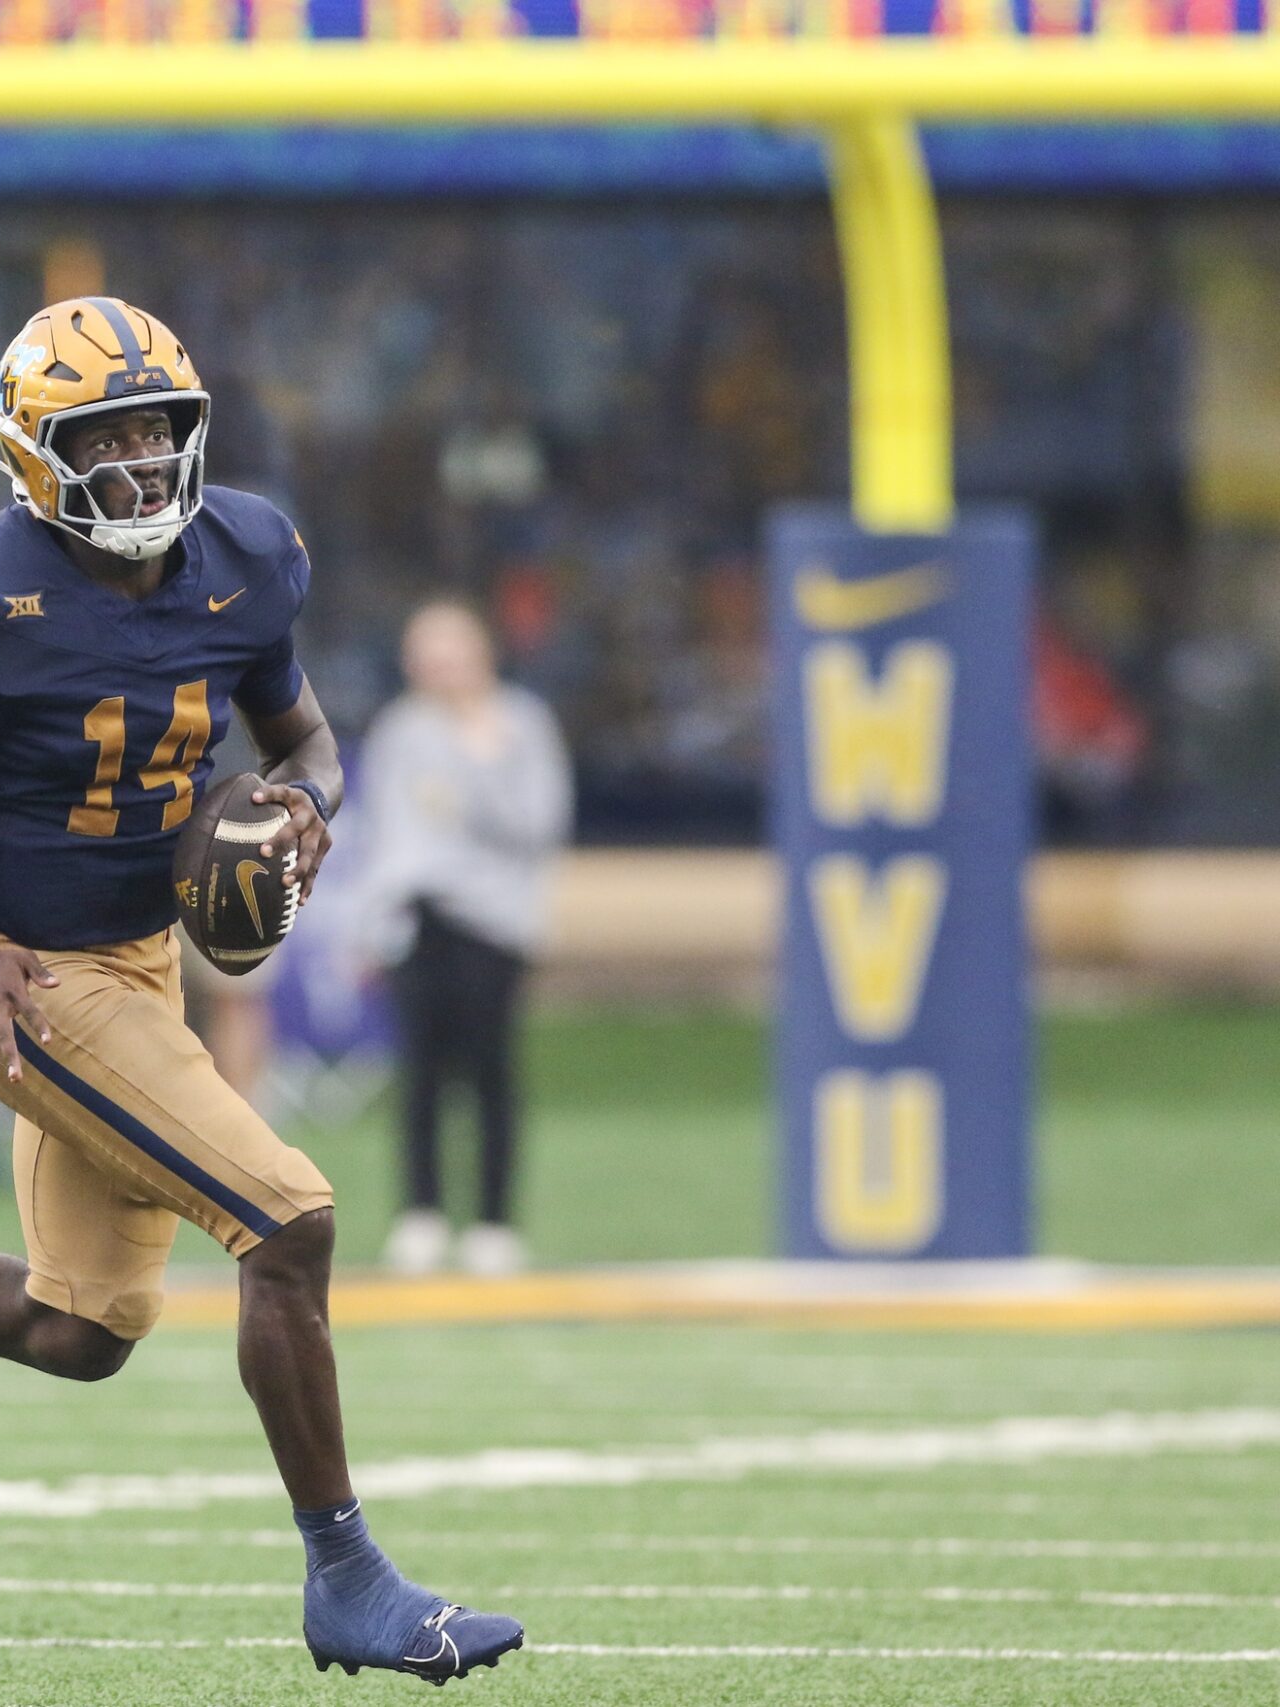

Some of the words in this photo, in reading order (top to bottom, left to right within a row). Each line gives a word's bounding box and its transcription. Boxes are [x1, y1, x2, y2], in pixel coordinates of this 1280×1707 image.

[3, 593, 45, 620] XII
[66, 679, 212, 838] 14
[804, 640, 954, 1252] WVU
